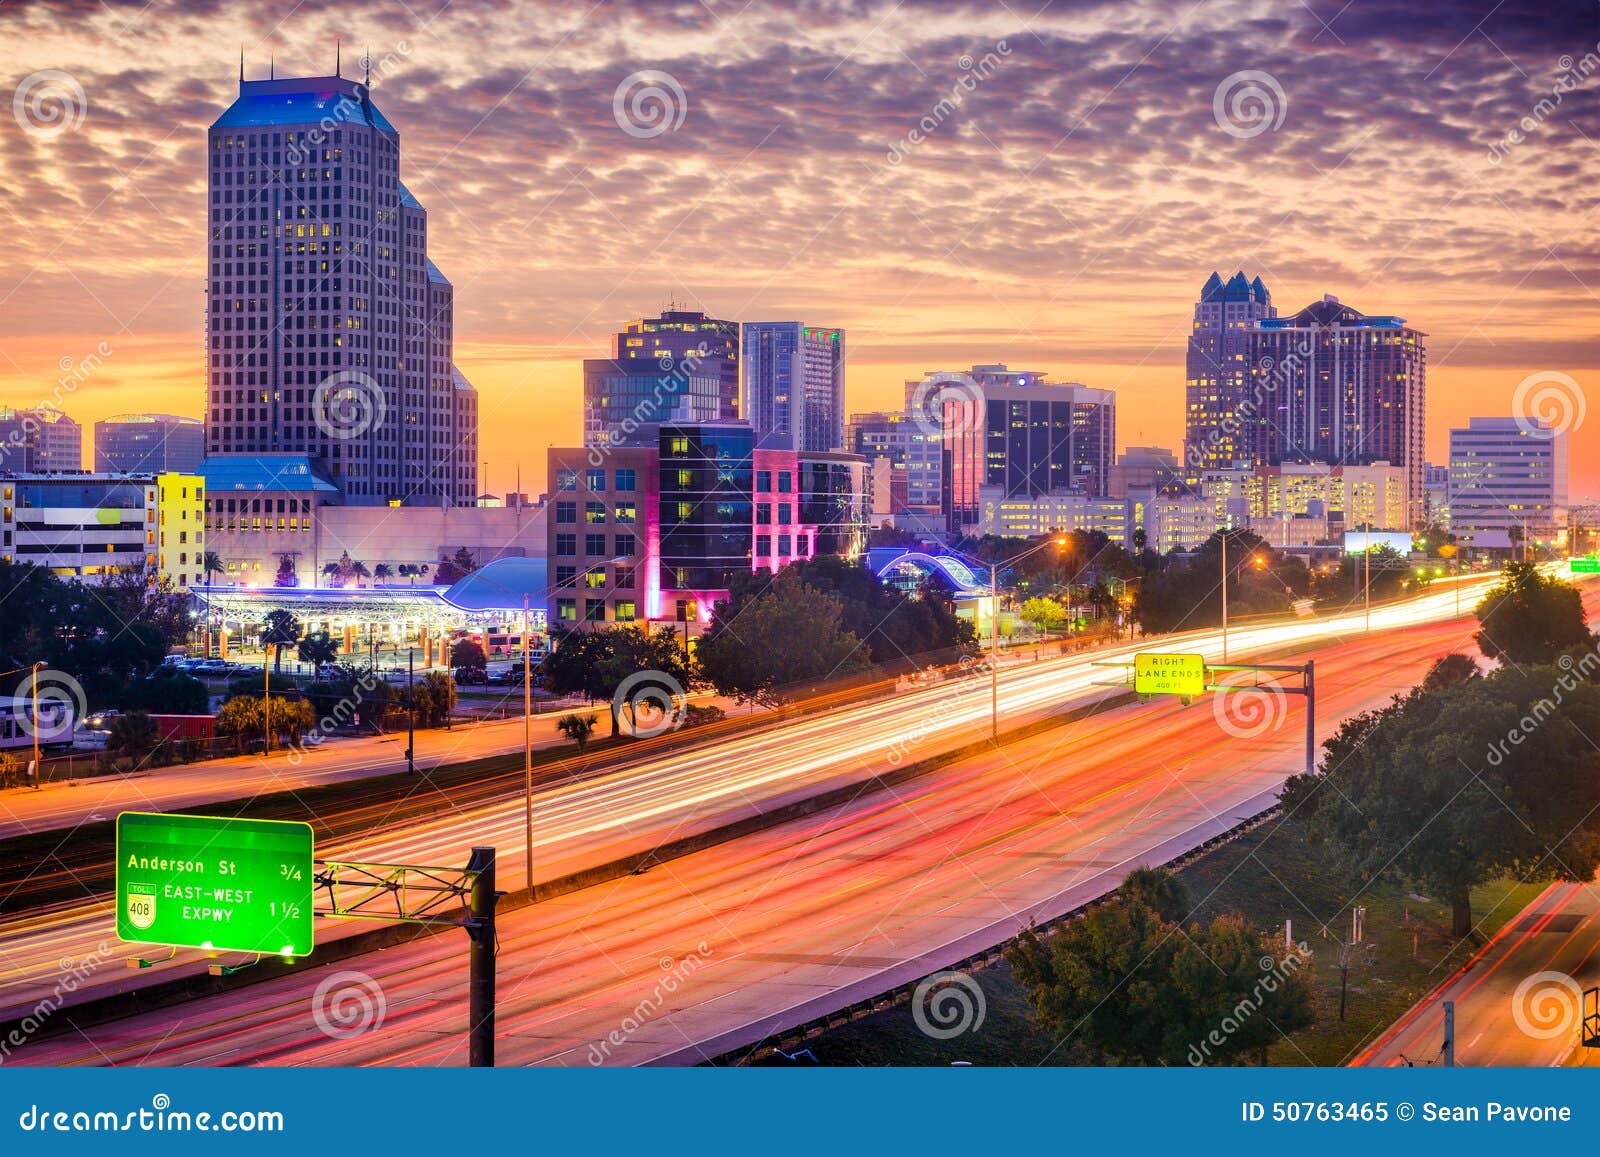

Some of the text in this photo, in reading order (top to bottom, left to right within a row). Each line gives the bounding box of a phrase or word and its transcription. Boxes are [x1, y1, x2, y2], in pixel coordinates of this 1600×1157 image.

[1137, 670, 1201, 678] LANE ENDS
[127, 854, 204, 873] Anderson
[218, 860, 236, 876] St
[132, 885, 149, 894] TOLL
[164, 884, 253, 904] EAST-WEST
[129, 902, 150, 916] 408
[182, 906, 234, 923] EXPWY
